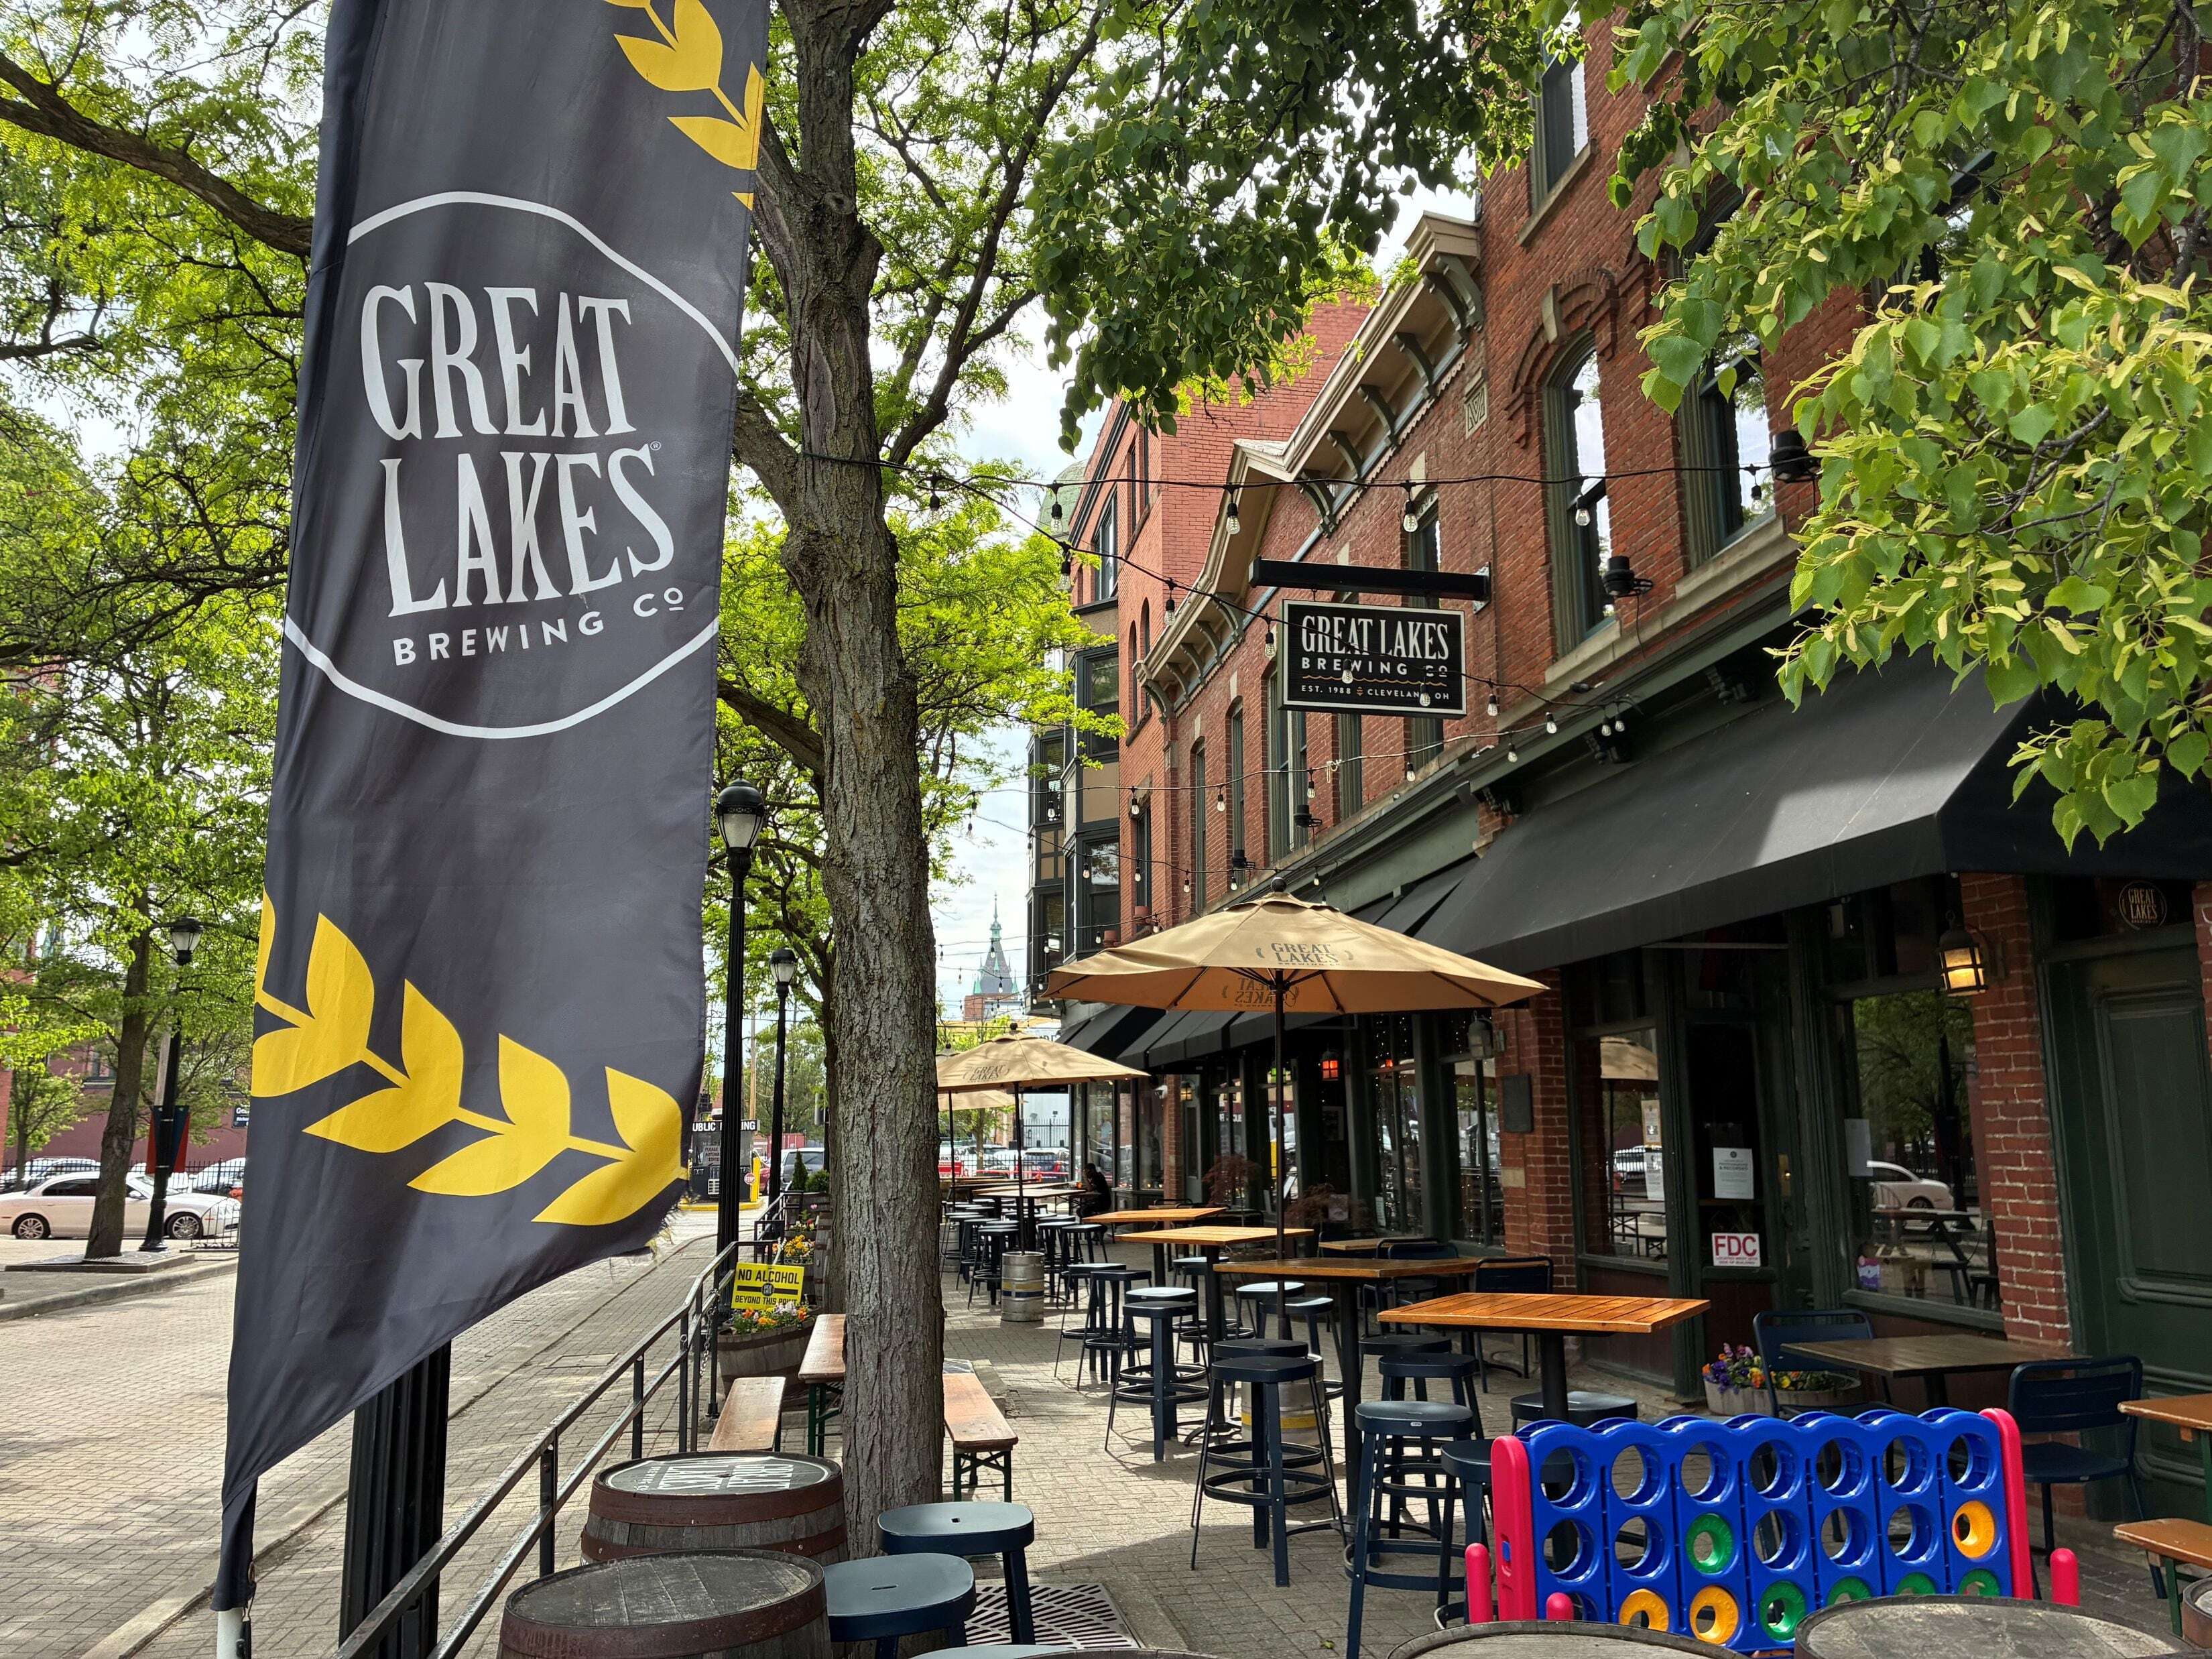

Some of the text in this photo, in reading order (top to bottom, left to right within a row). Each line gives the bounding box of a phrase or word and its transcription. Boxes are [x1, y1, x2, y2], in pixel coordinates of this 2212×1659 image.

[360, 282, 637, 441] GREAT
[380, 443, 674, 617] LAKES
[391, 611, 605, 666] BREWING
[1302, 615, 1449, 660] GREAT LAKES
[1302, 657, 1407, 676] BREWING
[1329, 686, 1351, 694] 1988
[1367, 688, 1422, 698] CLEVELAN
[2128, 888, 2156, 904] GREAT
[2130, 904, 2158, 920] LAKES
[1271, 942, 1331, 954] GREAT
[1274, 953, 1339, 963] LAKES
[969, 1072, 999, 1081] LAKES
[974, 1064, 1005, 1074] GREAT
[692, 1122, 716, 1131] UBLIC
[1715, 1235, 1758, 1257] FDC
[738, 1269, 800, 1284] NO ALCOHOL
[735, 1295, 761, 1304] BEYOND
[762, 1297, 777, 1305] THIS
[657, 1465, 729, 1490] LAKES
[727, 1464, 794, 1489] GREAT
